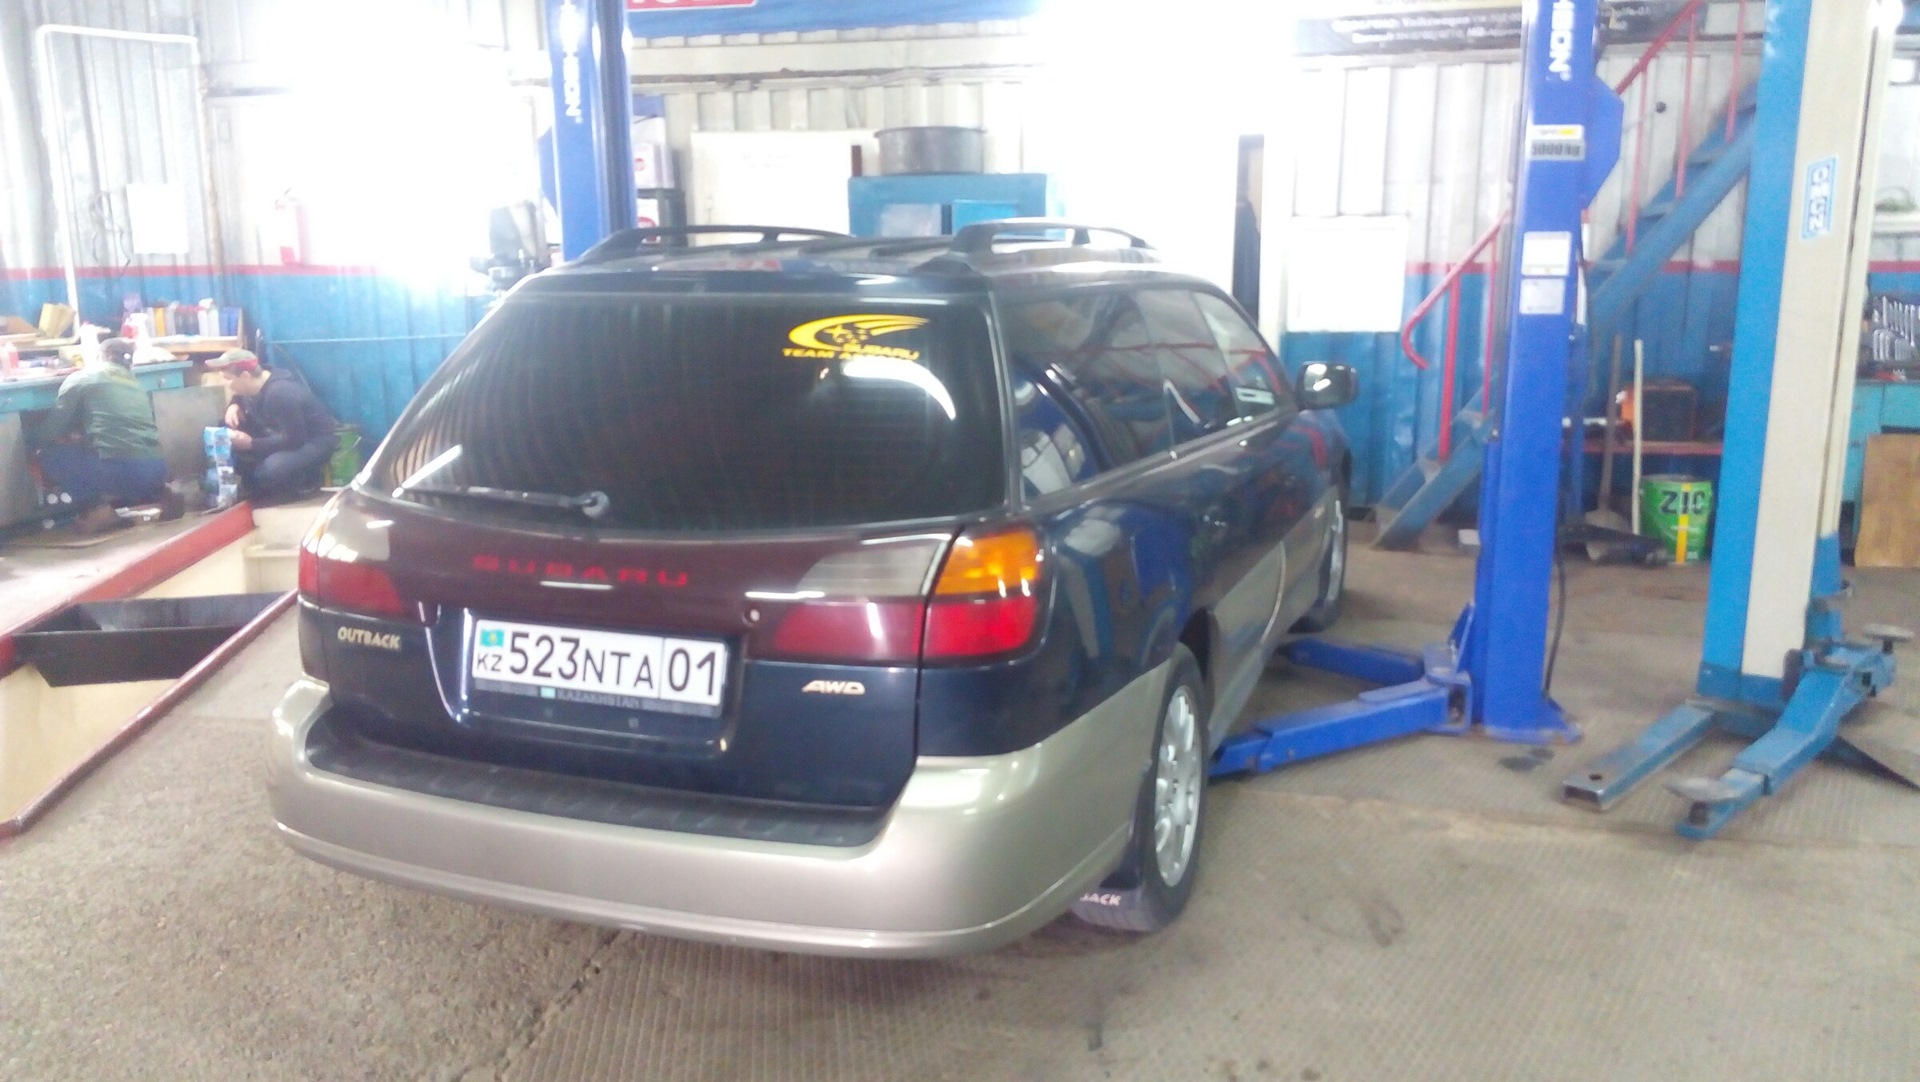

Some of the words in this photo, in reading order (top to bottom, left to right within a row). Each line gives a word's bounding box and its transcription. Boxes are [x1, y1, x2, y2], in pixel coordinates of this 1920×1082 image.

[783, 348, 835, 359] TEAM
[1660, 489, 1706, 516] ZIC
[473, 555, 689, 587] SUBARU
[337, 625, 401, 650] OUTBACK
[476, 652, 503, 673] KZ
[667, 647, 717, 697] 01
[801, 680, 866, 695] AWD
